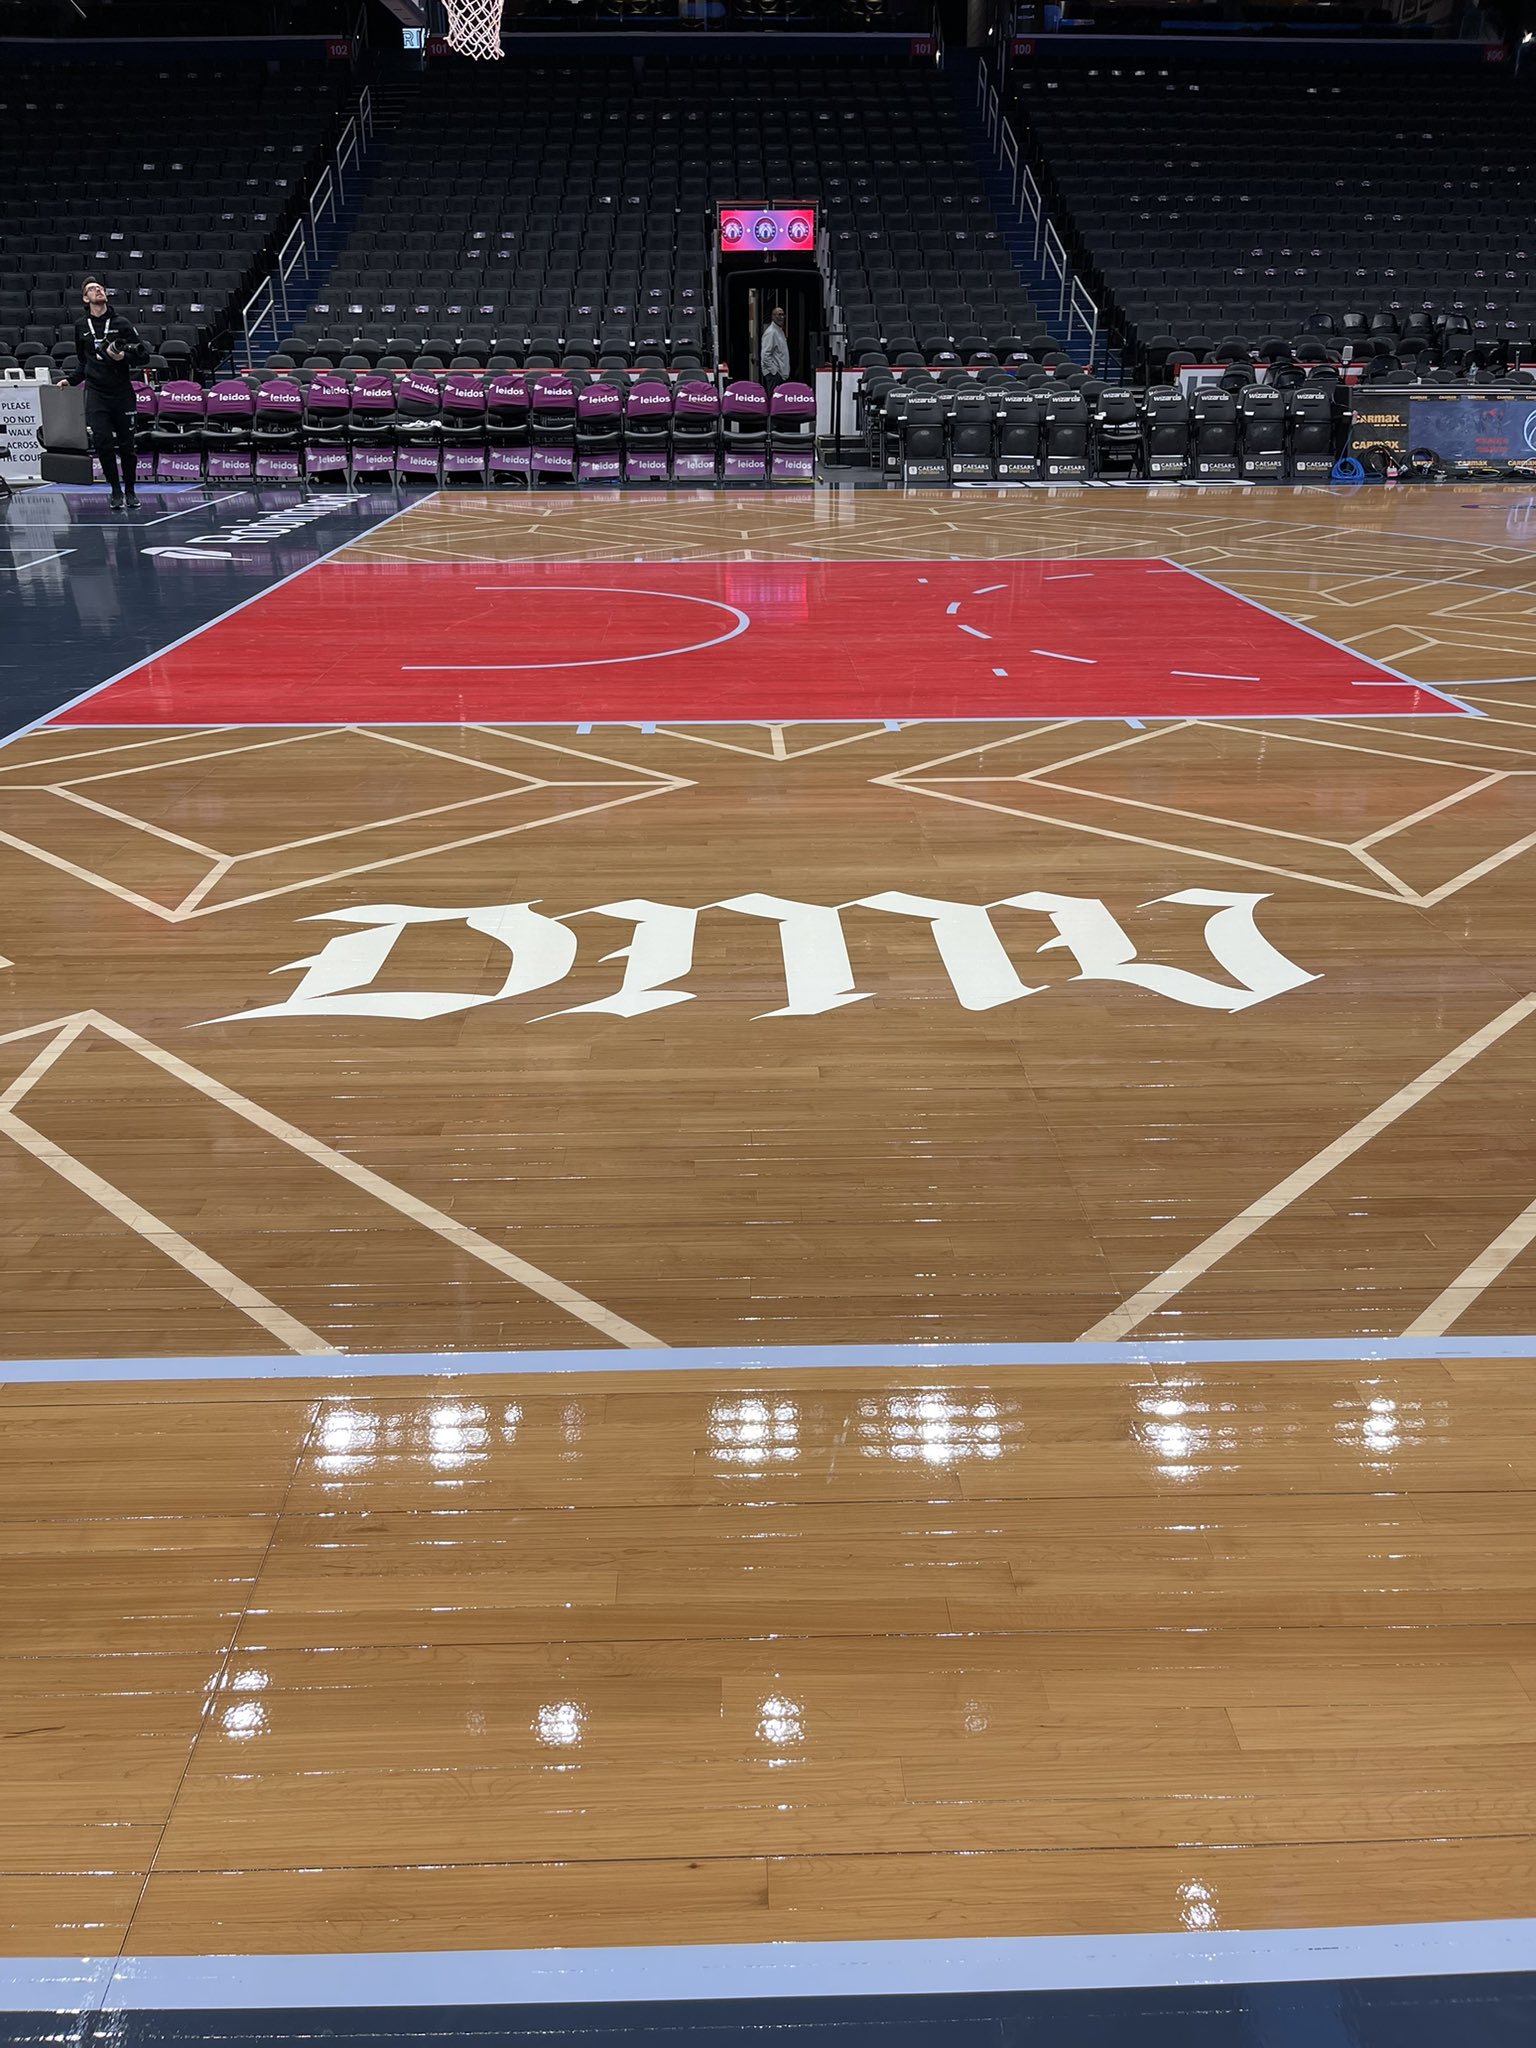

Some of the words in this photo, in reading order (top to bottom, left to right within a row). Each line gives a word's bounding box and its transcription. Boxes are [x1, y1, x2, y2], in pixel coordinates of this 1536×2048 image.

[330, 44, 348, 55] 102
[430, 43, 447, 54] 101
[914, 43, 931, 54] 101
[1014, 44, 1031, 54] 100
[363, 388, 392, 397] leidos
[411, 381, 439, 395] leidos
[495, 385, 524, 395] leidos
[544, 387, 573, 395] leidos
[172, 393, 202, 401] leidos
[220, 393, 250, 401] leidos
[455, 388, 484, 398] leidos
[957, 393, 985, 401] wizards
[1153, 393, 1182, 401] wizards
[1201, 393, 1229, 401] wizards
[1248, 391, 1278, 399] wizards
[1297, 391, 1325, 399] wizards
[270, 394, 301, 402] leidos
[589, 395, 619, 404] leidos
[640, 395, 671, 404] leidos
[688, 394, 718, 402] leidos
[735, 393, 765, 403] leidos
[784, 394, 815, 403] leidos
[2, 402, 31, 410] PLEASE
[7, 441, 38, 449] ACROSS
[319, 455, 346, 463] leidos
[366, 455, 393, 463] leidos
[410, 456, 437, 466] leidos
[457, 455, 484, 464] leidos
[503, 455, 530, 464] leidos
[545, 455, 572, 465] leidos
[172, 461, 199, 470] leidos
[222, 460, 250, 469] leidos
[270, 461, 297, 470] leidos
[592, 461, 619, 470] leidos
[639, 460, 666, 468] leidos
[687, 461, 714, 469] leidos
[738, 460, 764, 468] leidos
[785, 460, 812, 469] leidos
[186, 493, 371, 543] Robinhood
